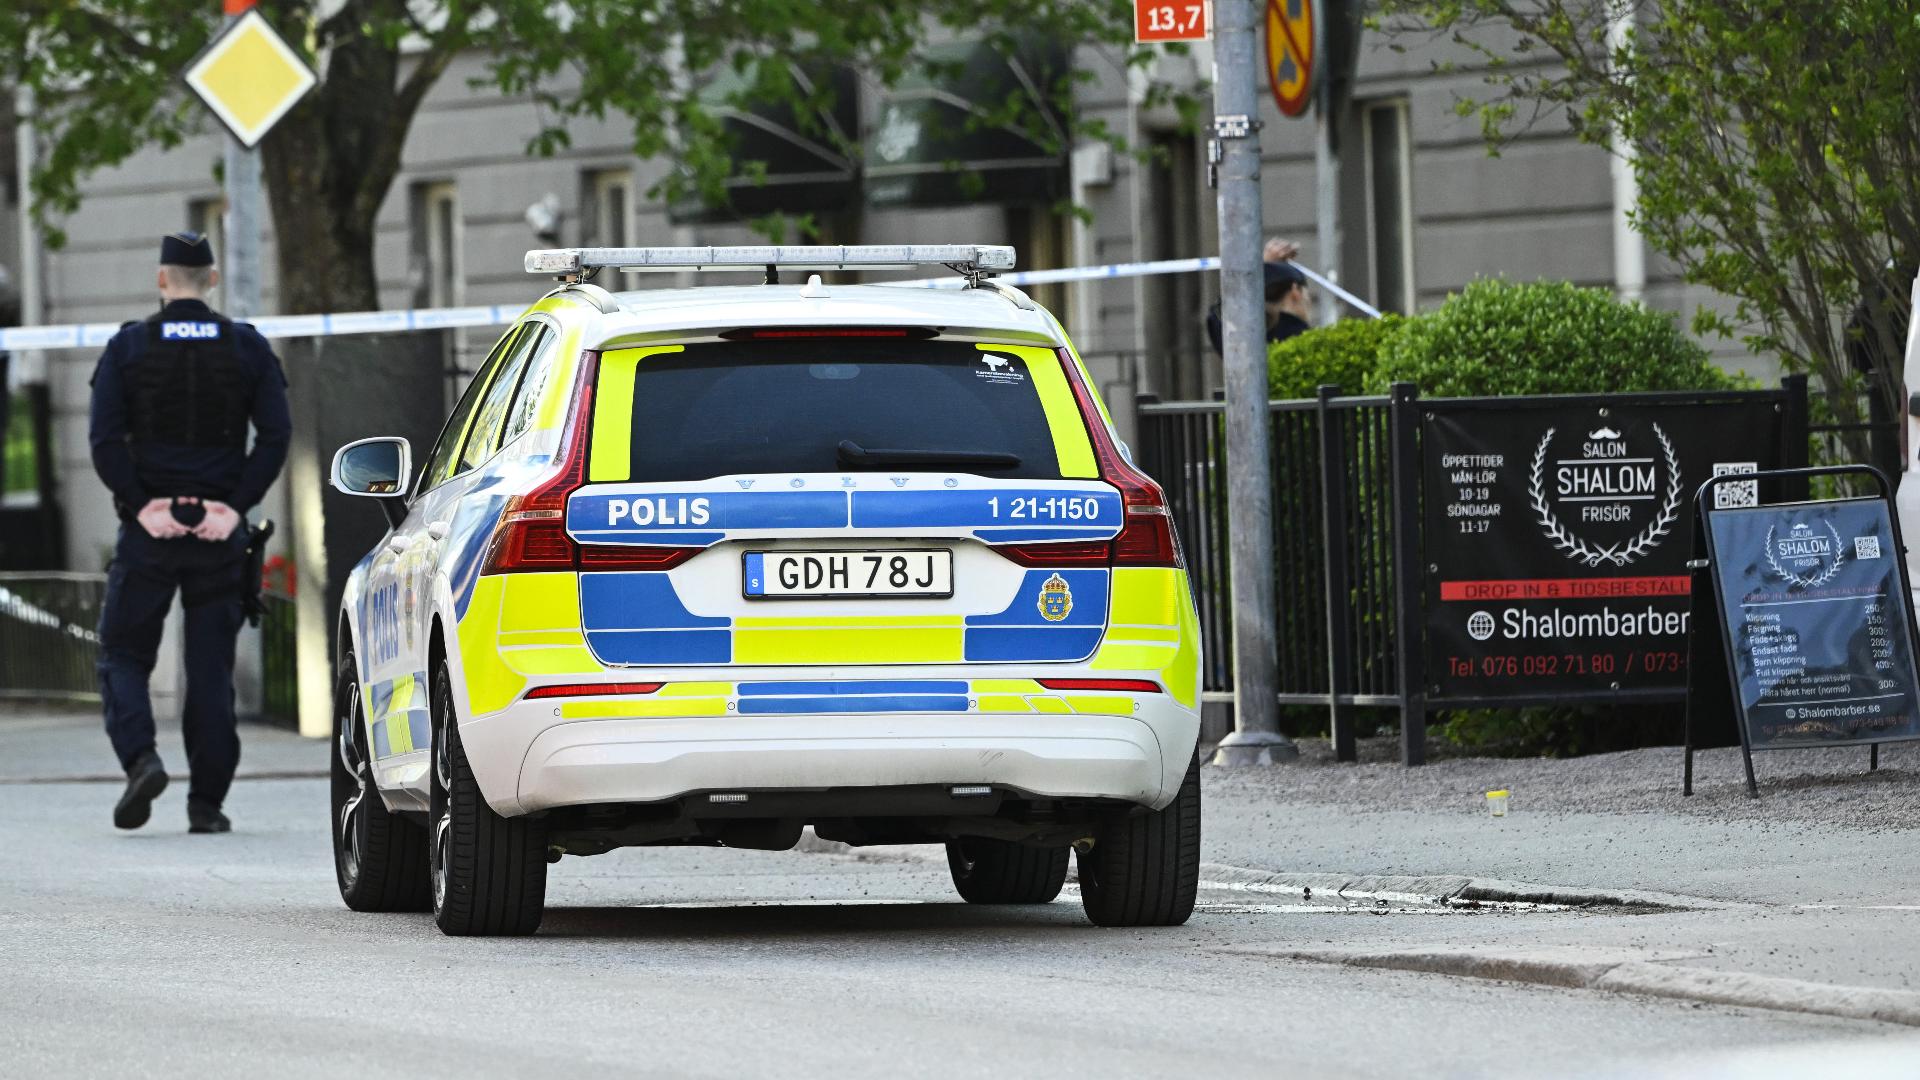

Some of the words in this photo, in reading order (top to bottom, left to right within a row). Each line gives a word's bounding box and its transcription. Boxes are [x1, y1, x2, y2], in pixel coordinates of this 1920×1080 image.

[1147, 5, 1202, 34] 13,7
[162, 322, 218, 338] POLIS
[1583, 441, 1627, 459] SALON
[1442, 452, 1504, 468] ÖPPETTIDER
[736, 477, 959, 490] VOLVO
[1451, 469, 1497, 484] MÅN-LÖR
[1557, 465, 1656, 495] SHALOM
[1459, 487, 1490, 501] 10-19
[608, 497, 710, 526] POLIS
[987, 496, 999, 518] 1
[1010, 497, 1099, 520] 21-1150
[1447, 502, 1501, 517] SÖNDAGAR
[1582, 502, 1631, 522] FRISÖR
[1460, 520, 1490, 533] 11-17
[1779, 539, 1831, 556] SHALOM
[751, 578, 760, 588] S
[778, 556, 849, 590] GDH
[862, 555, 934, 588] 78J
[1465, 583, 1518, 599] DROP
[1523, 583, 1541, 597] IN
[1547, 582, 1560, 596] &
[1503, 605, 1691, 639] Shalombarber
[1751, 646, 1778, 656] Endast
[1484, 656, 1518, 677] 076
[1523, 655, 1558, 676] 092
[1564, 654, 1586, 675] 71
[1591, 654, 1615, 674] 80
[1625, 652, 1634, 675] /
[1645, 651, 1689, 673] 073-
[1753, 657, 1772, 667] Barn
[1773, 656, 1807, 666] klippning
[1755, 668, 1770, 678] Full
[1771, 667, 1805, 677] klippning
[1798, 704, 1881, 719] Shalombarber.se
